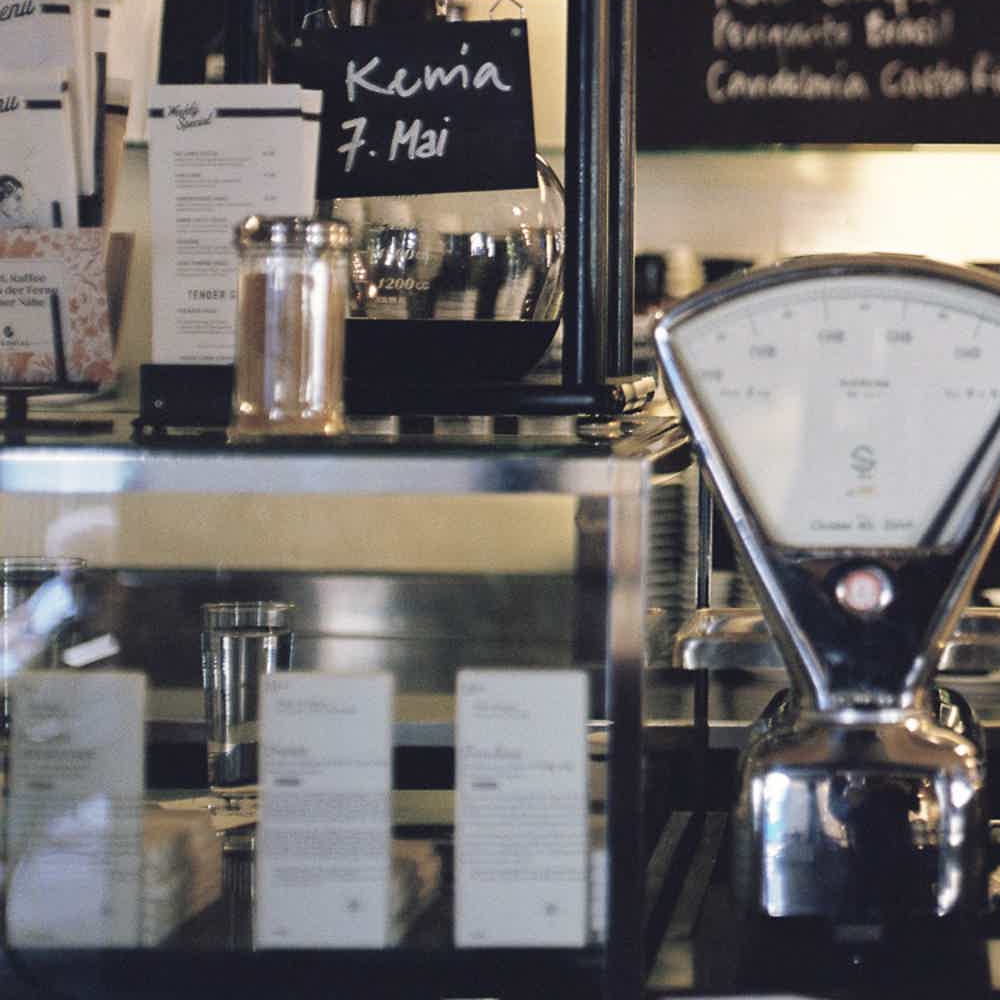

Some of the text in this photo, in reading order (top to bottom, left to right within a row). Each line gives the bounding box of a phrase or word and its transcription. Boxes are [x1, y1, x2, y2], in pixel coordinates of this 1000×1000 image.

[0, 0, 36, 21] enu
[879, 60, 968, 101] Costa
[337, 116, 451, 172] 7. Mai
